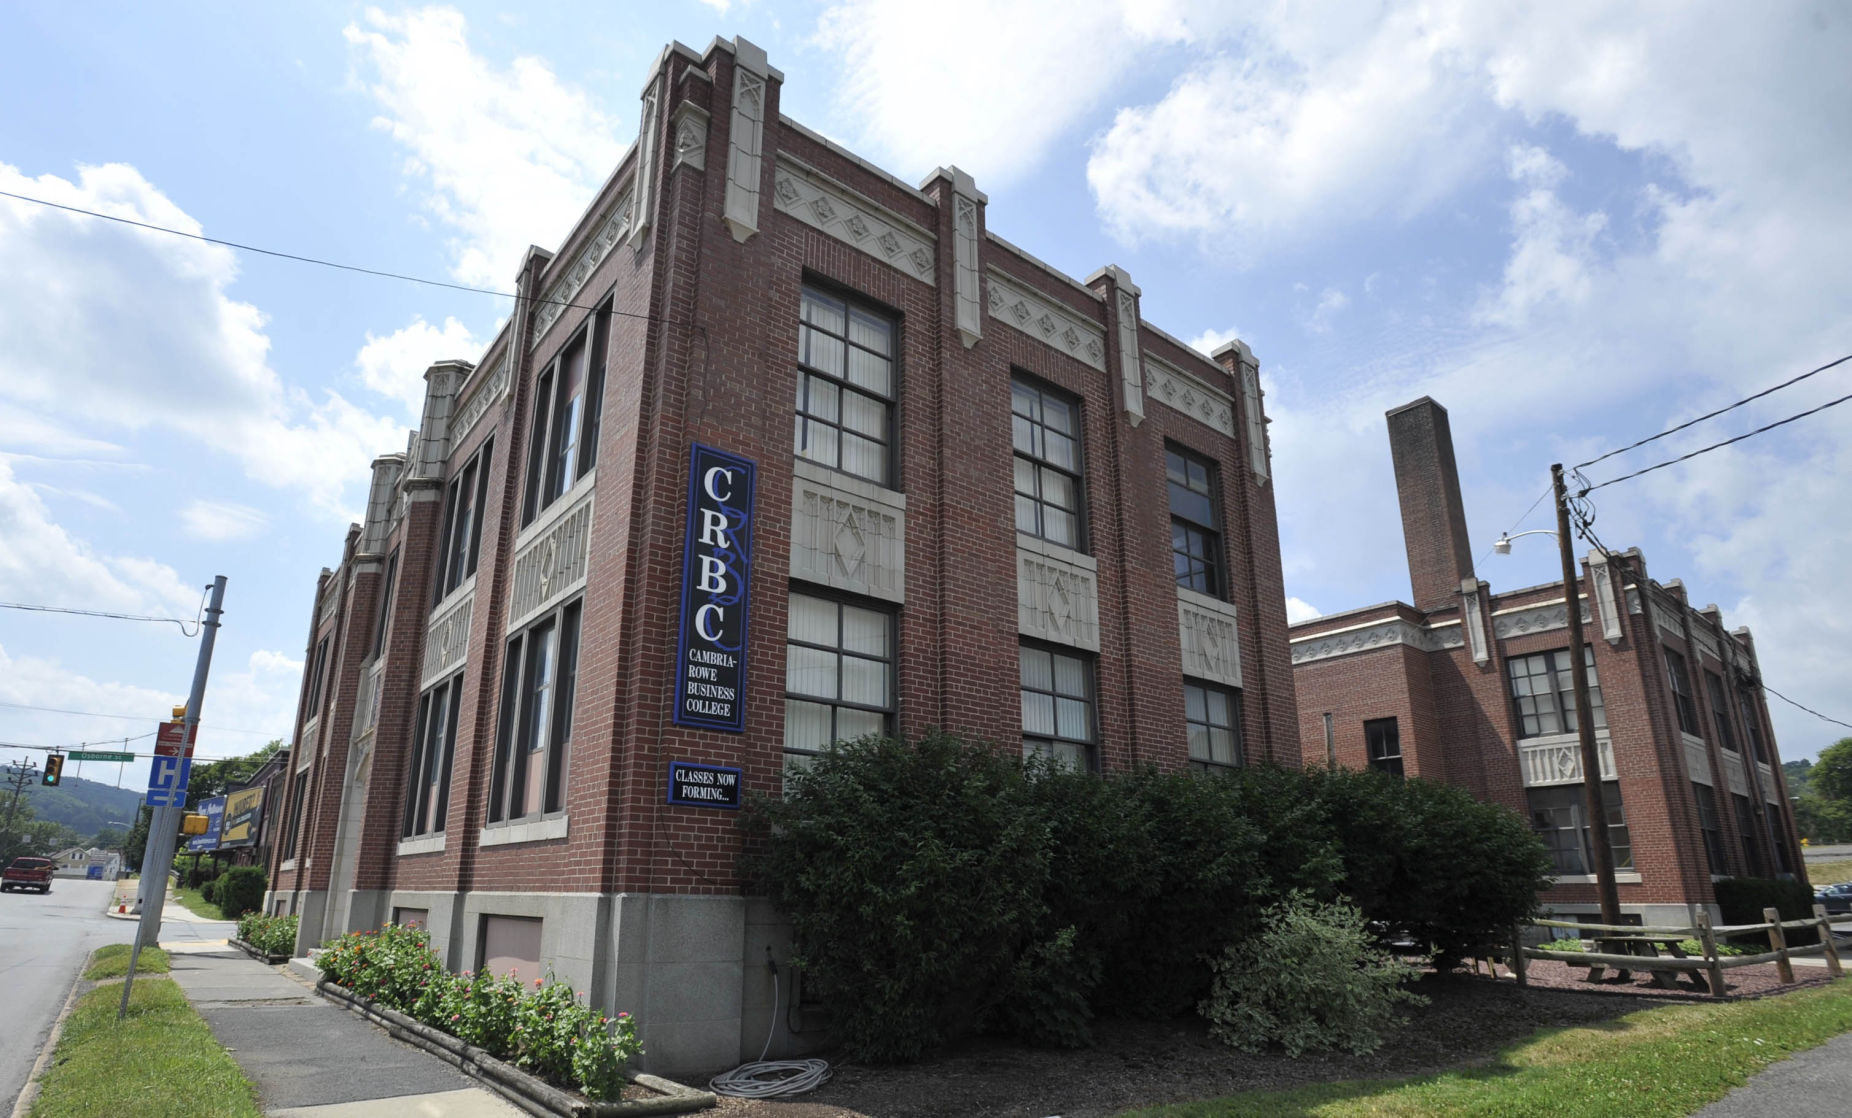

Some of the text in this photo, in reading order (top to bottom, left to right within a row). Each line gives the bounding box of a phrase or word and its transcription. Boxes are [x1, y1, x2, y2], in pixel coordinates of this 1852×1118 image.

[695, 466, 732, 642] CRBC
[688, 648, 738, 668] CAMBRIA-
[688, 664, 718, 682] ROWE
[687, 681, 735, 701] BUSINESS
[686, 698, 731, 717] COLLEGE
[157, 760, 183, 787] H
[675, 769, 737, 786] CLASSES NOW
[682, 785, 729, 801] FORMING...
